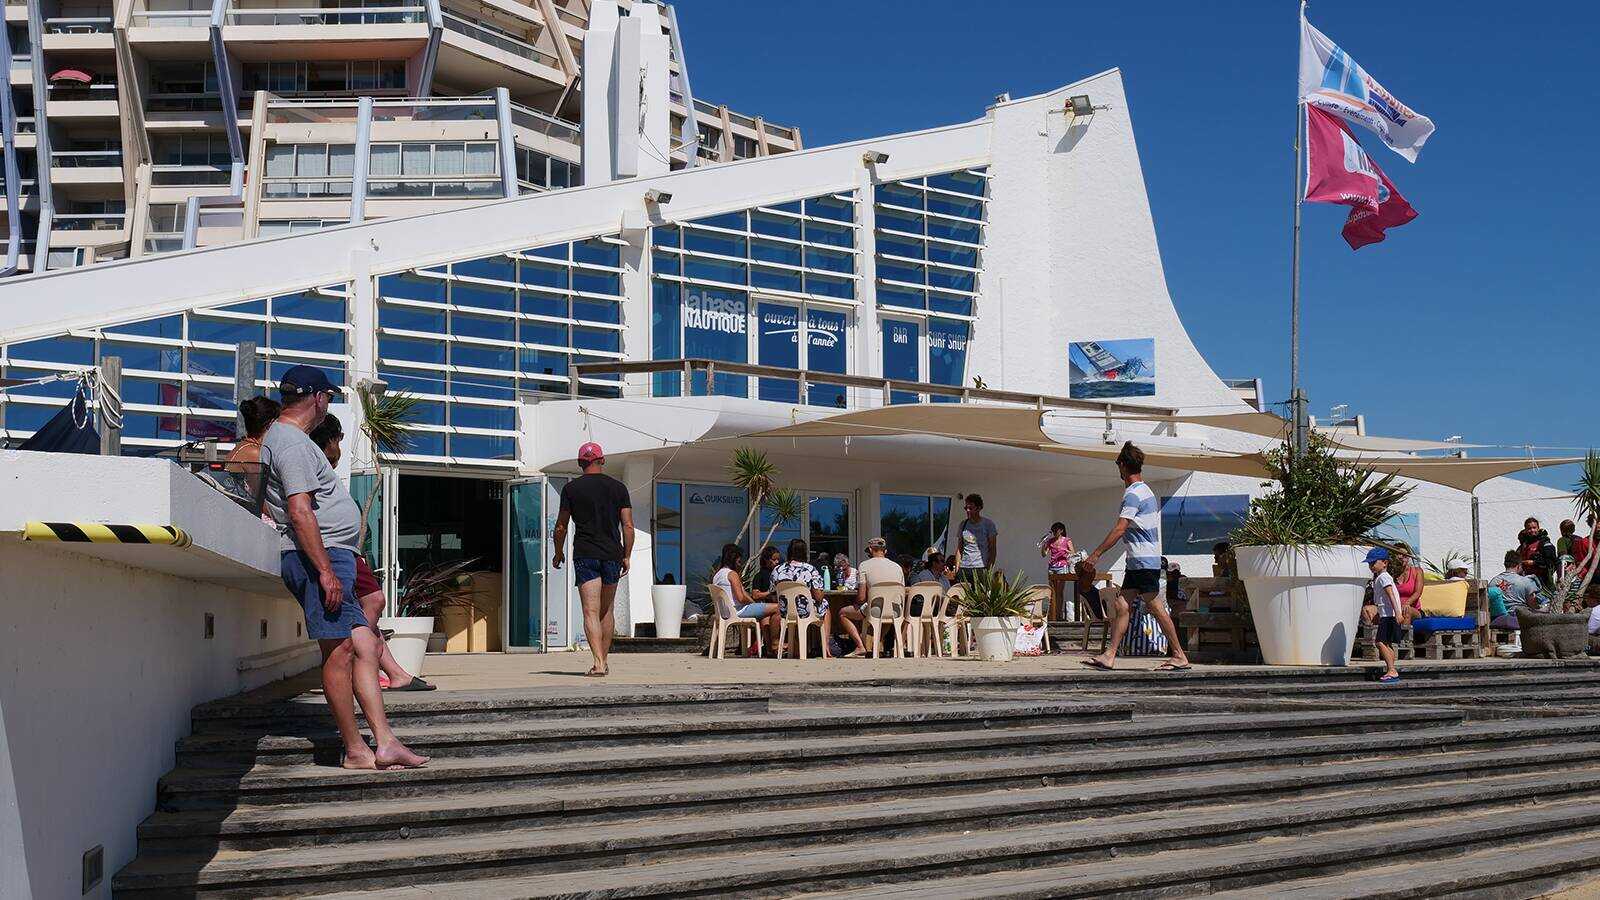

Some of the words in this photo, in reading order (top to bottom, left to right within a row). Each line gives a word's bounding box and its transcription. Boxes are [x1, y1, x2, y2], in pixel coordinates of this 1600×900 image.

[685, 289, 698, 308] la
[702, 291, 745, 314] base
[684, 306, 746, 334] NAUTIQUE
[764, 312, 797, 327] ouvert
[818, 316, 839, 331] tous
[893, 326, 908, 344] BAR
[928, 330, 946, 348] SURF
[947, 333, 967, 351] SHOP
[704, 494, 744, 504] QUIKSILVER
